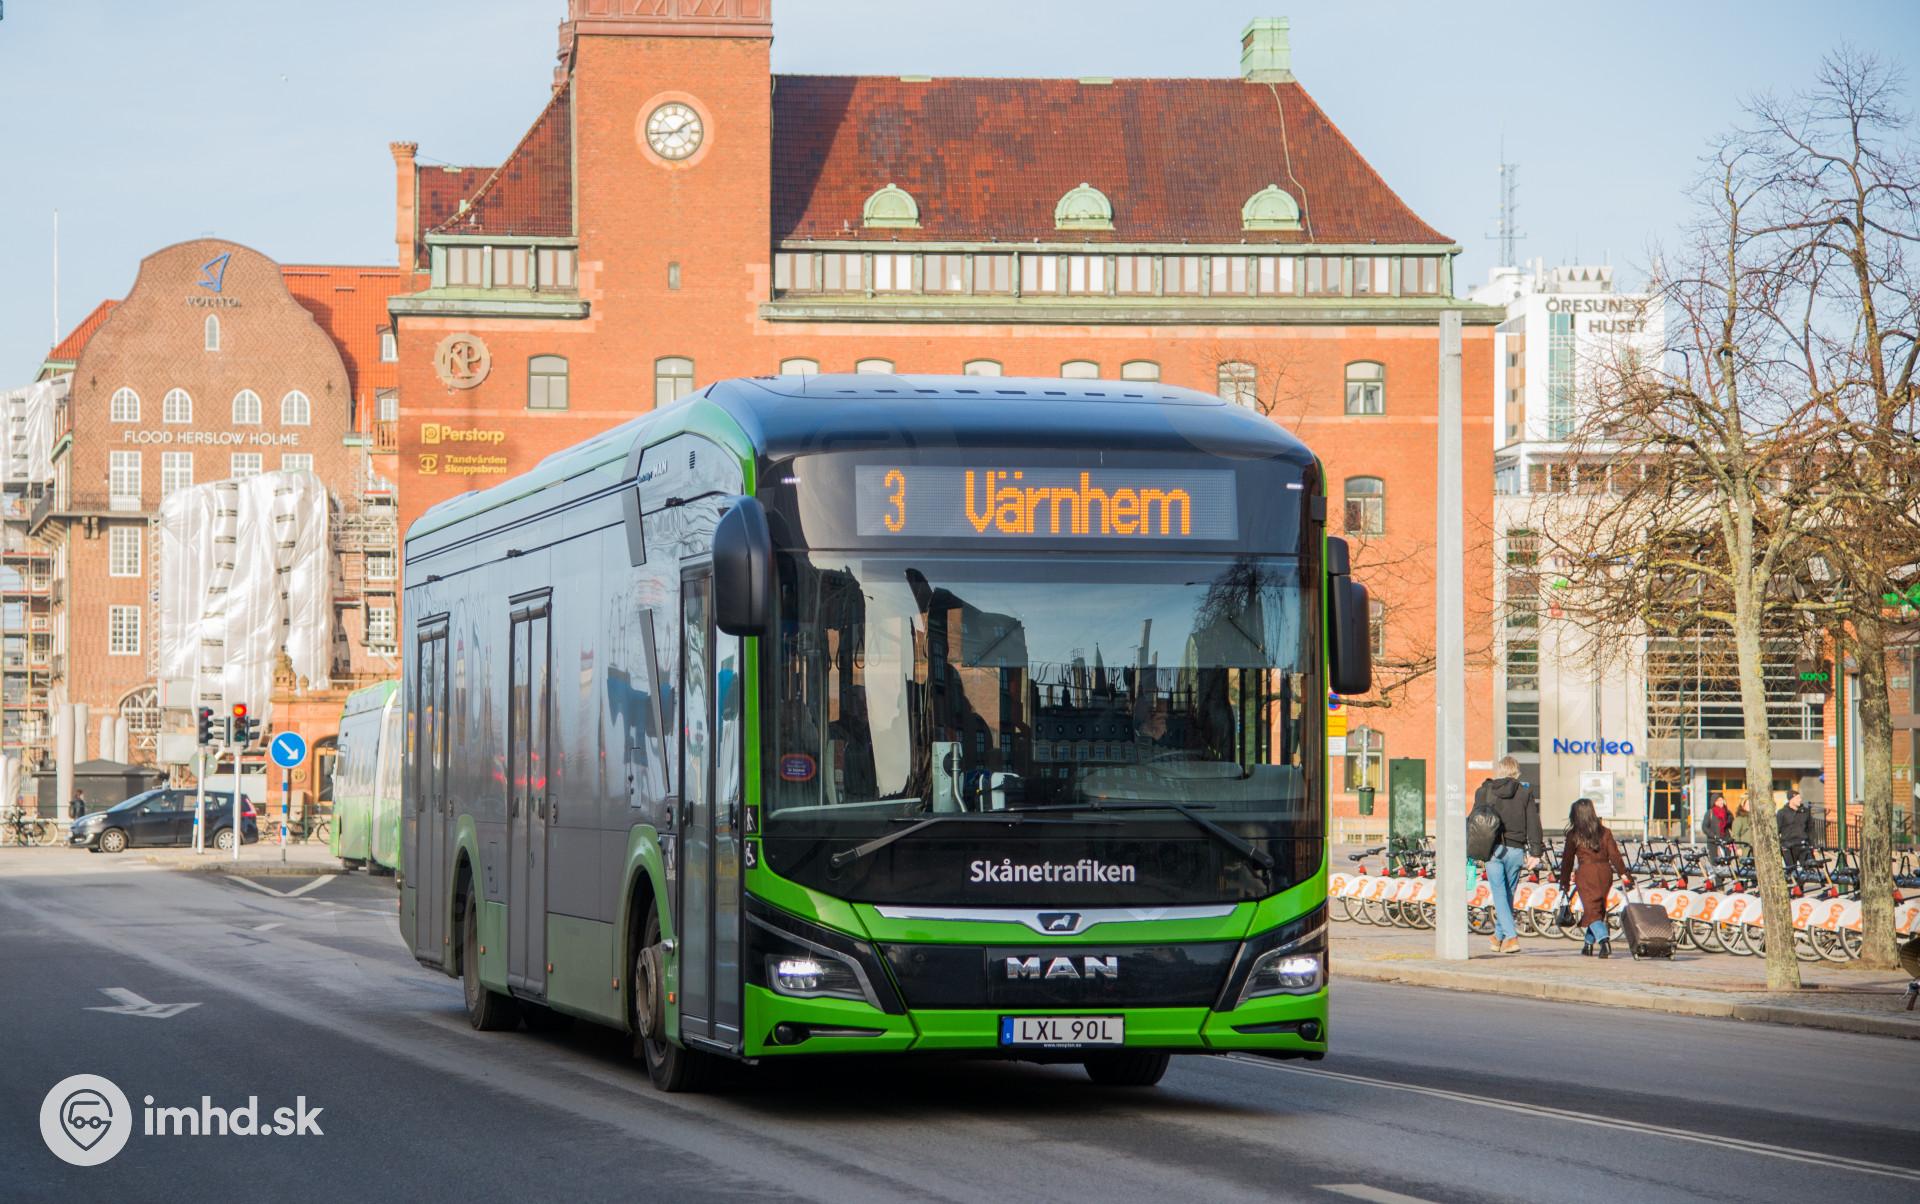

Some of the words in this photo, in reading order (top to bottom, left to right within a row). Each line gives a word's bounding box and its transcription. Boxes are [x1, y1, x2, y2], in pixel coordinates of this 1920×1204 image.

[124, 430, 173, 444] FLOOD
[177, 431, 245, 445] HERSLOW
[250, 432, 299, 445] HOLME
[441, 425, 505, 445] Perstorp
[444, 464, 507, 475] Skeppsbron
[445, 454, 507, 465] Tandvården
[884, 469, 905, 532] 3
[965, 470, 1191, 535] Värnhem
[1552, 737, 1634, 755] Nordea
[969, 858, 1136, 882] Skånetrafiken
[1006, 956, 1118, 979] MAN
[1022, 1020, 1063, 1041] LXL
[1071, 1020, 1113, 1041] 90L
